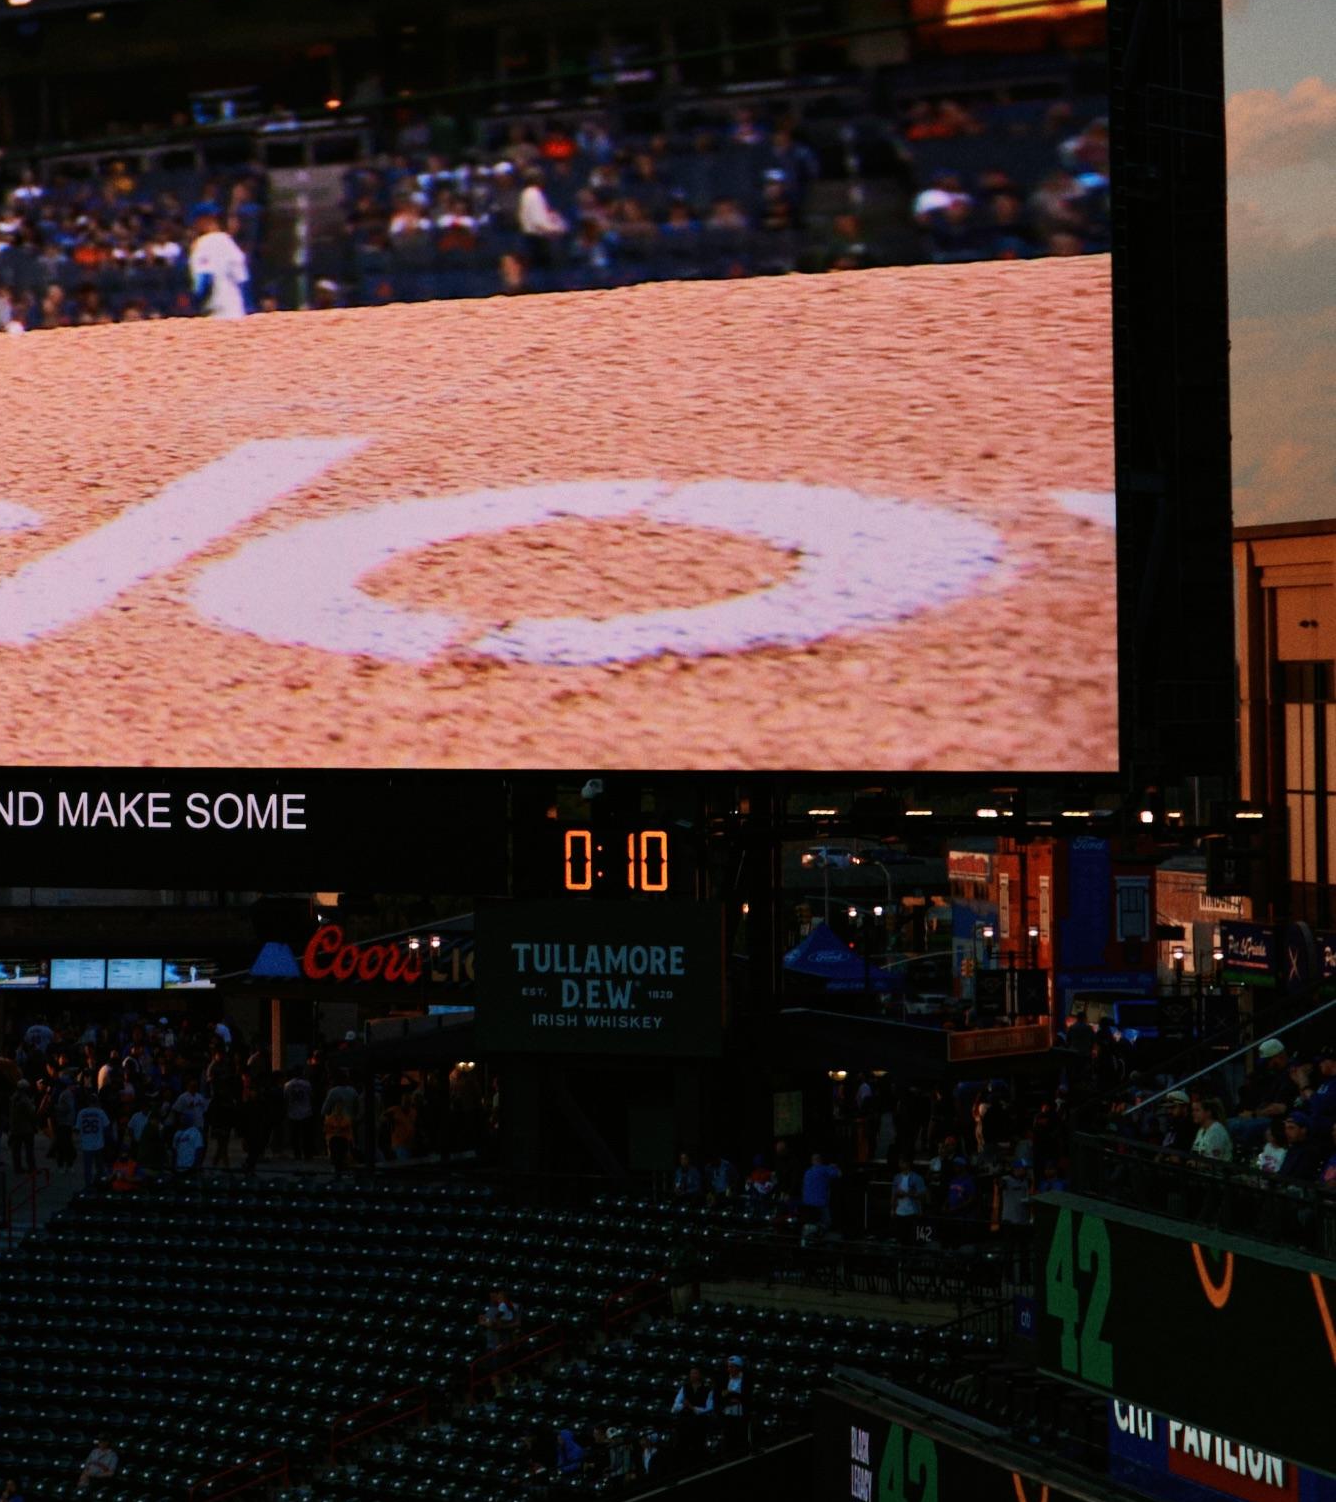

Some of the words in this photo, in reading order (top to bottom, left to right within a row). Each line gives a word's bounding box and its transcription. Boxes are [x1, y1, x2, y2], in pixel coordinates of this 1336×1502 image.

[58, 791, 171, 829] MAKE
[184, 792, 307, 830] SOME
[302, 923, 423, 984] Coors
[512, 943, 686, 976] TULLAMORE
[532, 1014, 578, 1027] IRISH
[585, 1015, 663, 1029] WHISKEY
[1046, 1206, 1114, 1392] 42
[1169, 1418, 1286, 1489] PAVILION
